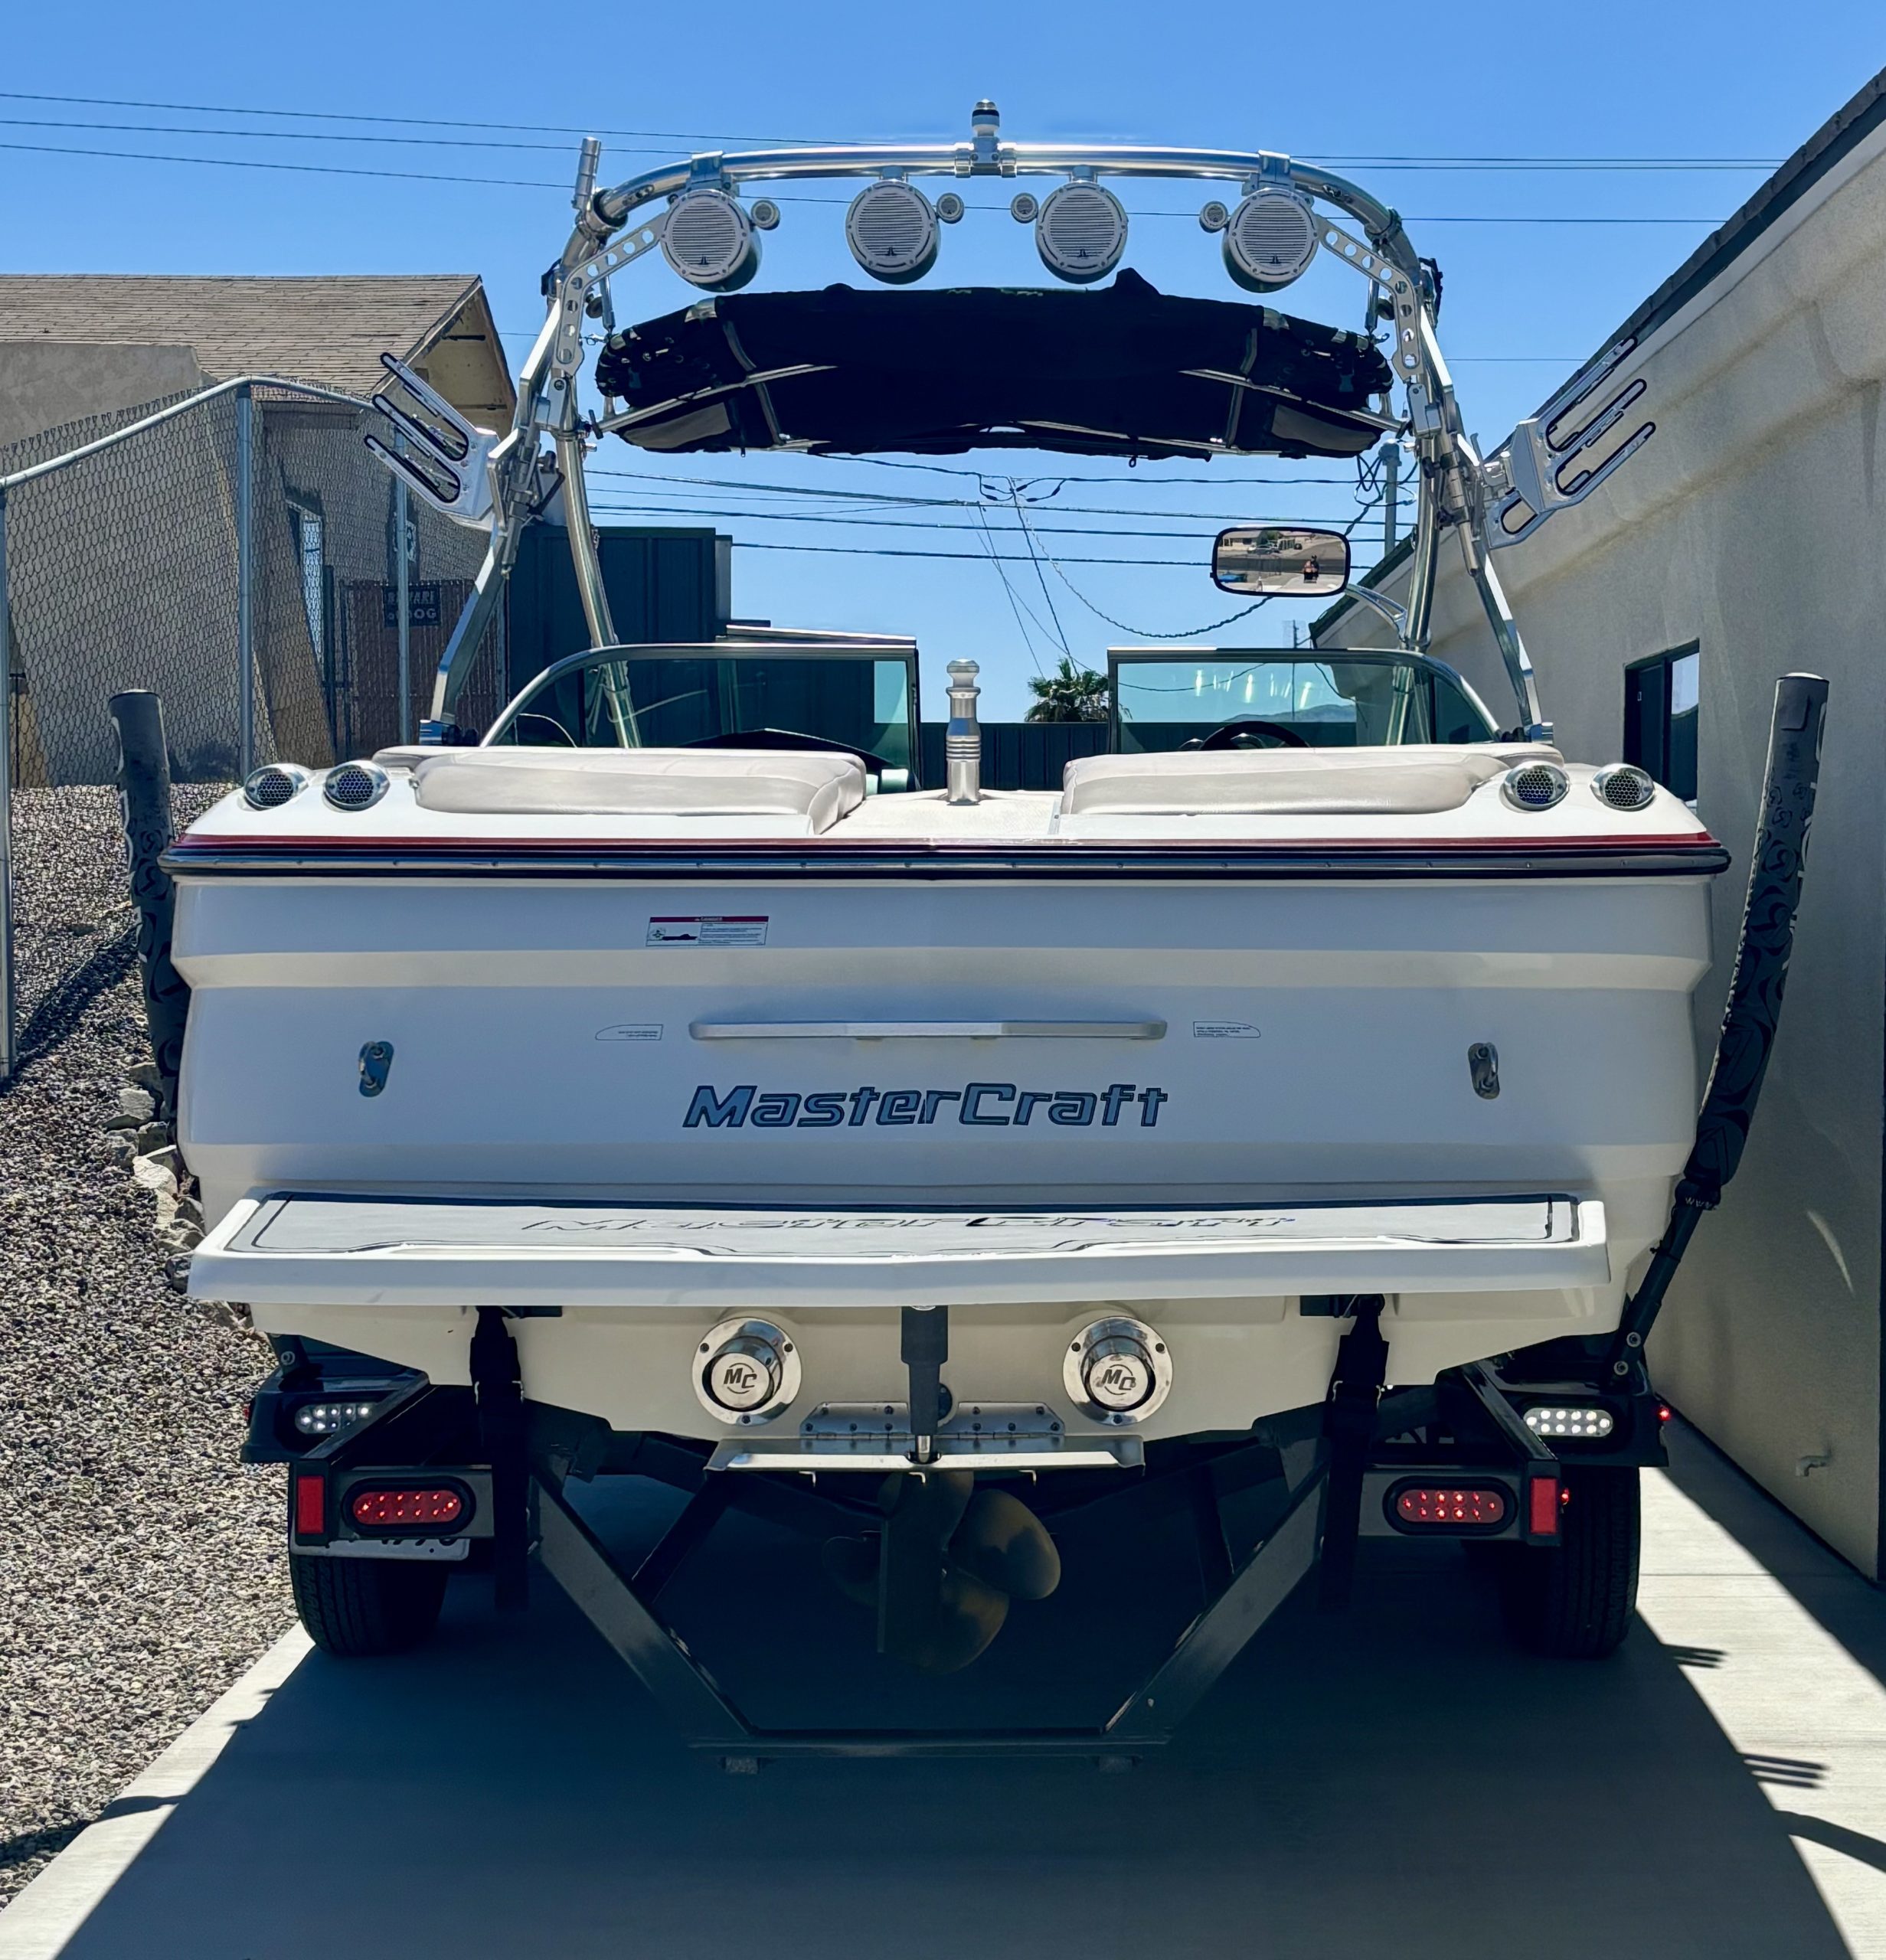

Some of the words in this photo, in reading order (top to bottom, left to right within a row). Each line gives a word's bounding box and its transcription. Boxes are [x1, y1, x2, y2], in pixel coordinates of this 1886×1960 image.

[682, 1082, 1169, 1128] MasterCraft
[723, 1367, 757, 1389] MC
[1102, 1369, 1136, 1390] MC
